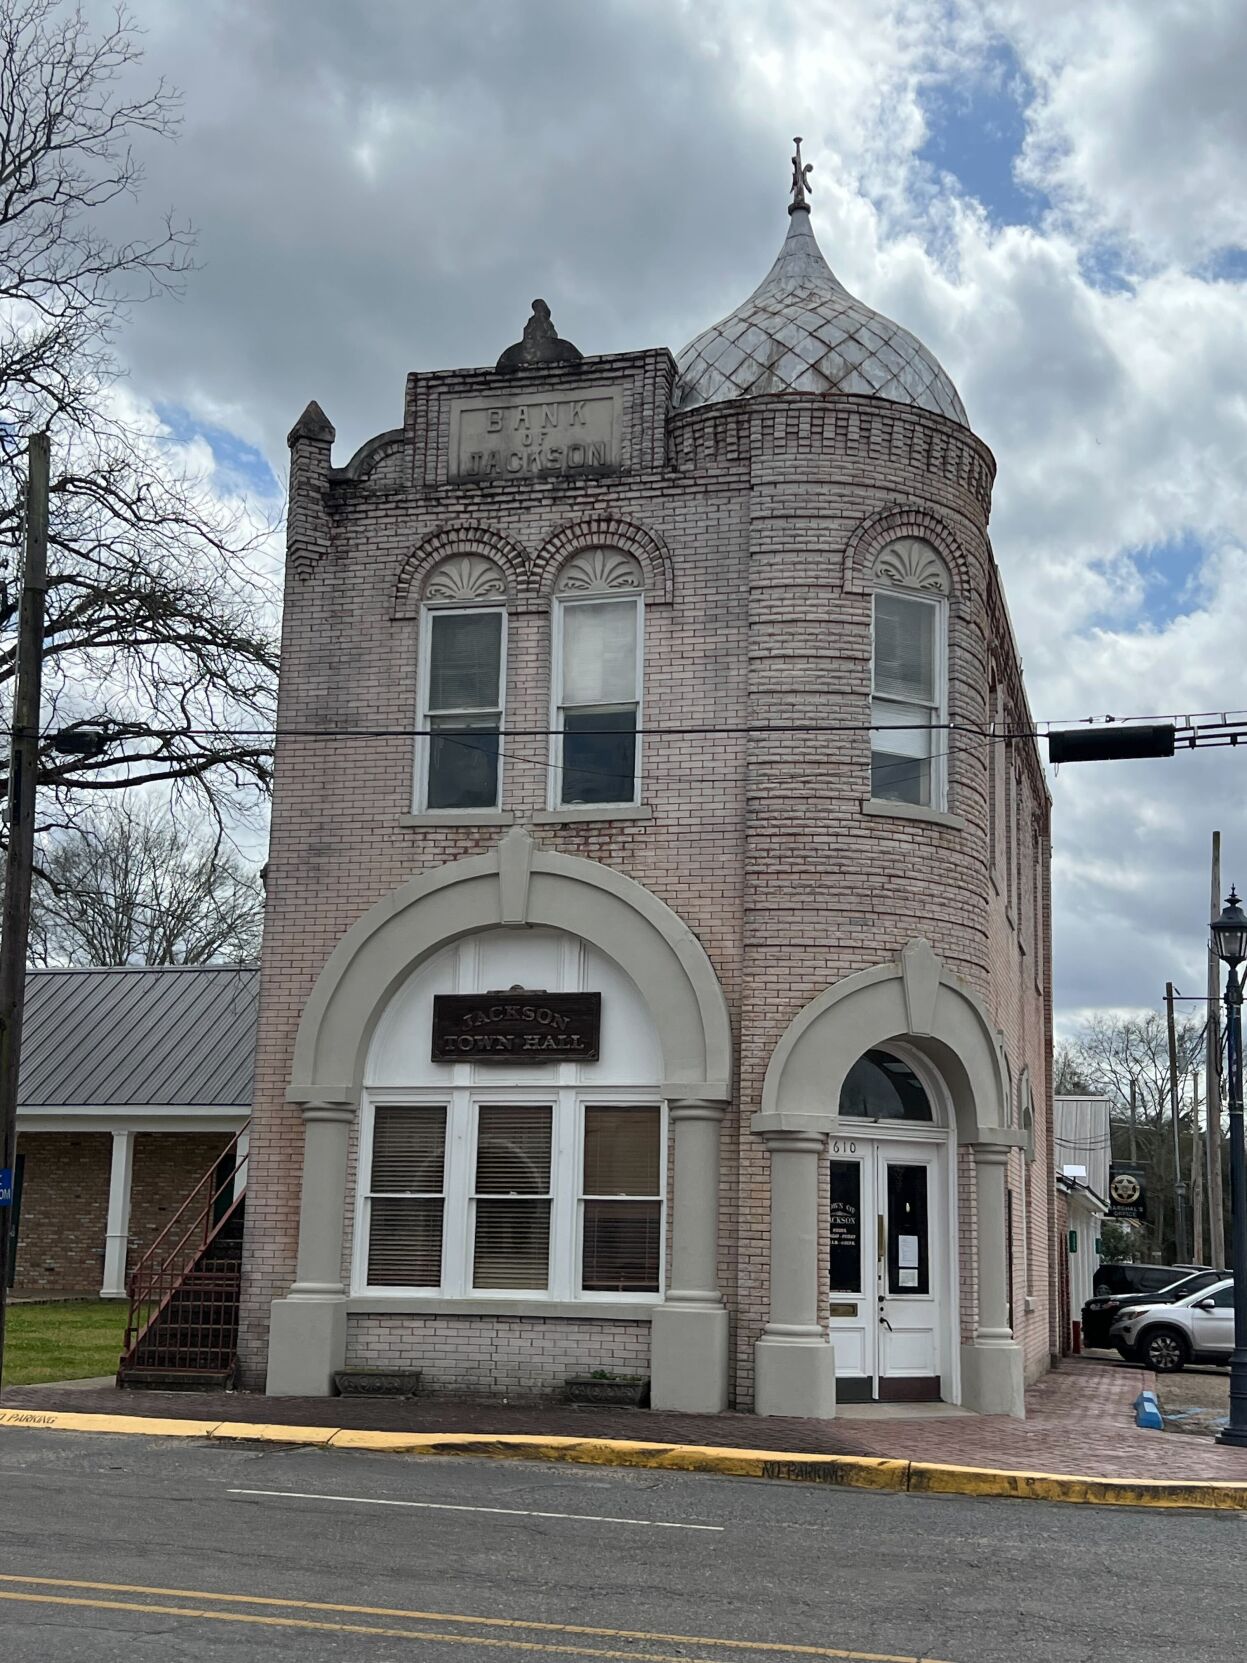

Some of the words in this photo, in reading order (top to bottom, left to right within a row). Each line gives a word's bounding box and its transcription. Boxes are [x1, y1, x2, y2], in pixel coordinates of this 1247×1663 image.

[487, 401, 586, 433] BANK
[522, 432, 548, 447] OF
[467, 441, 606, 476] JACKSON
[461, 1005, 570, 1031] JACKSON
[444, 1035, 515, 1050] TOWN
[522, 1035, 584, 1050] HALL
[833, 1141, 857, 1153] 610
[830, 1216, 856, 1224] CKSON
[6, 1413, 58, 1424] PARKING
